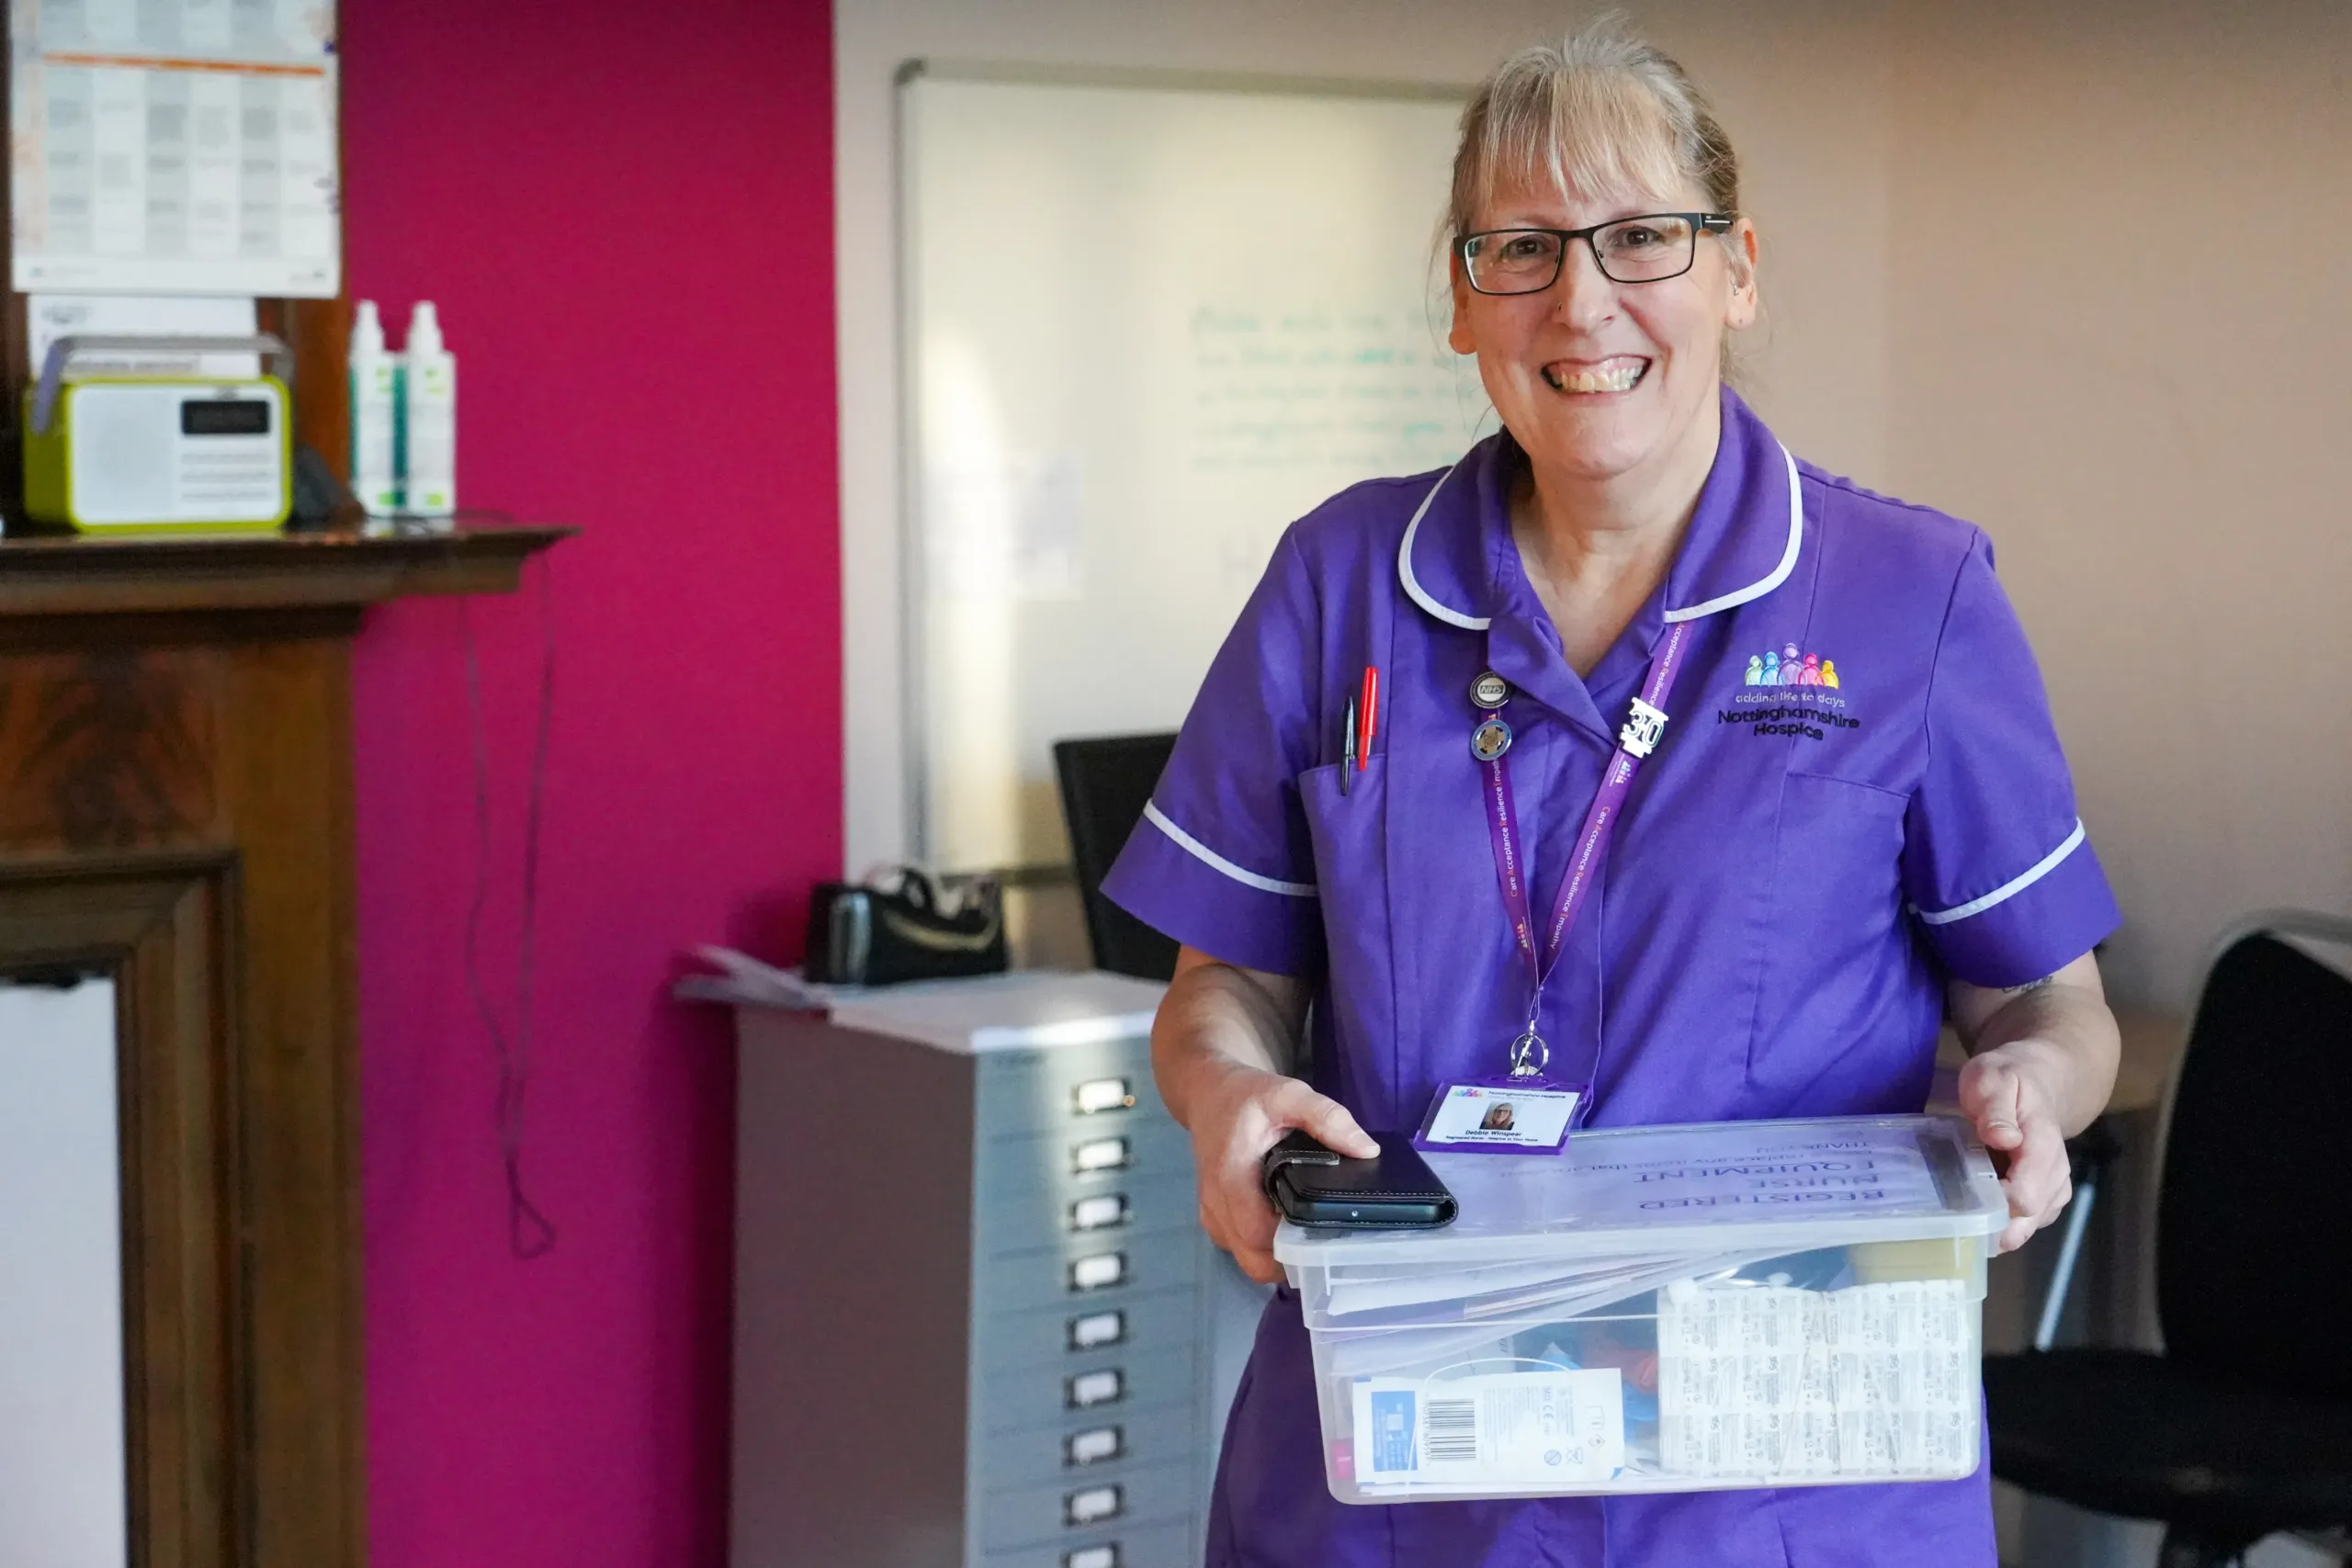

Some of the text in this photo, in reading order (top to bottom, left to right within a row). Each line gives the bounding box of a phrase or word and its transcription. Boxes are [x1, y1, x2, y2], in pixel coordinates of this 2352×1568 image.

[1480, 686, 1501, 694] NHS
[1648, 668, 1669, 705] Resilience
[1735, 692, 1846, 708] adding life to days
[1718, 705, 1860, 728] Nottinghamshire
[1754, 722, 1825, 741] Hospice
[1494, 786, 1508, 827] Resilience
[1501, 827, 1514, 876] Acceptance
[1550, 807, 1611, 950] Care Acceptance Resilience Empathy
[1633, 1159, 1874, 1182] EQUIPMENT
[1749, 1173, 1878, 1189] NURSE
[1639, 1190, 1883, 1210] REGISTERED
